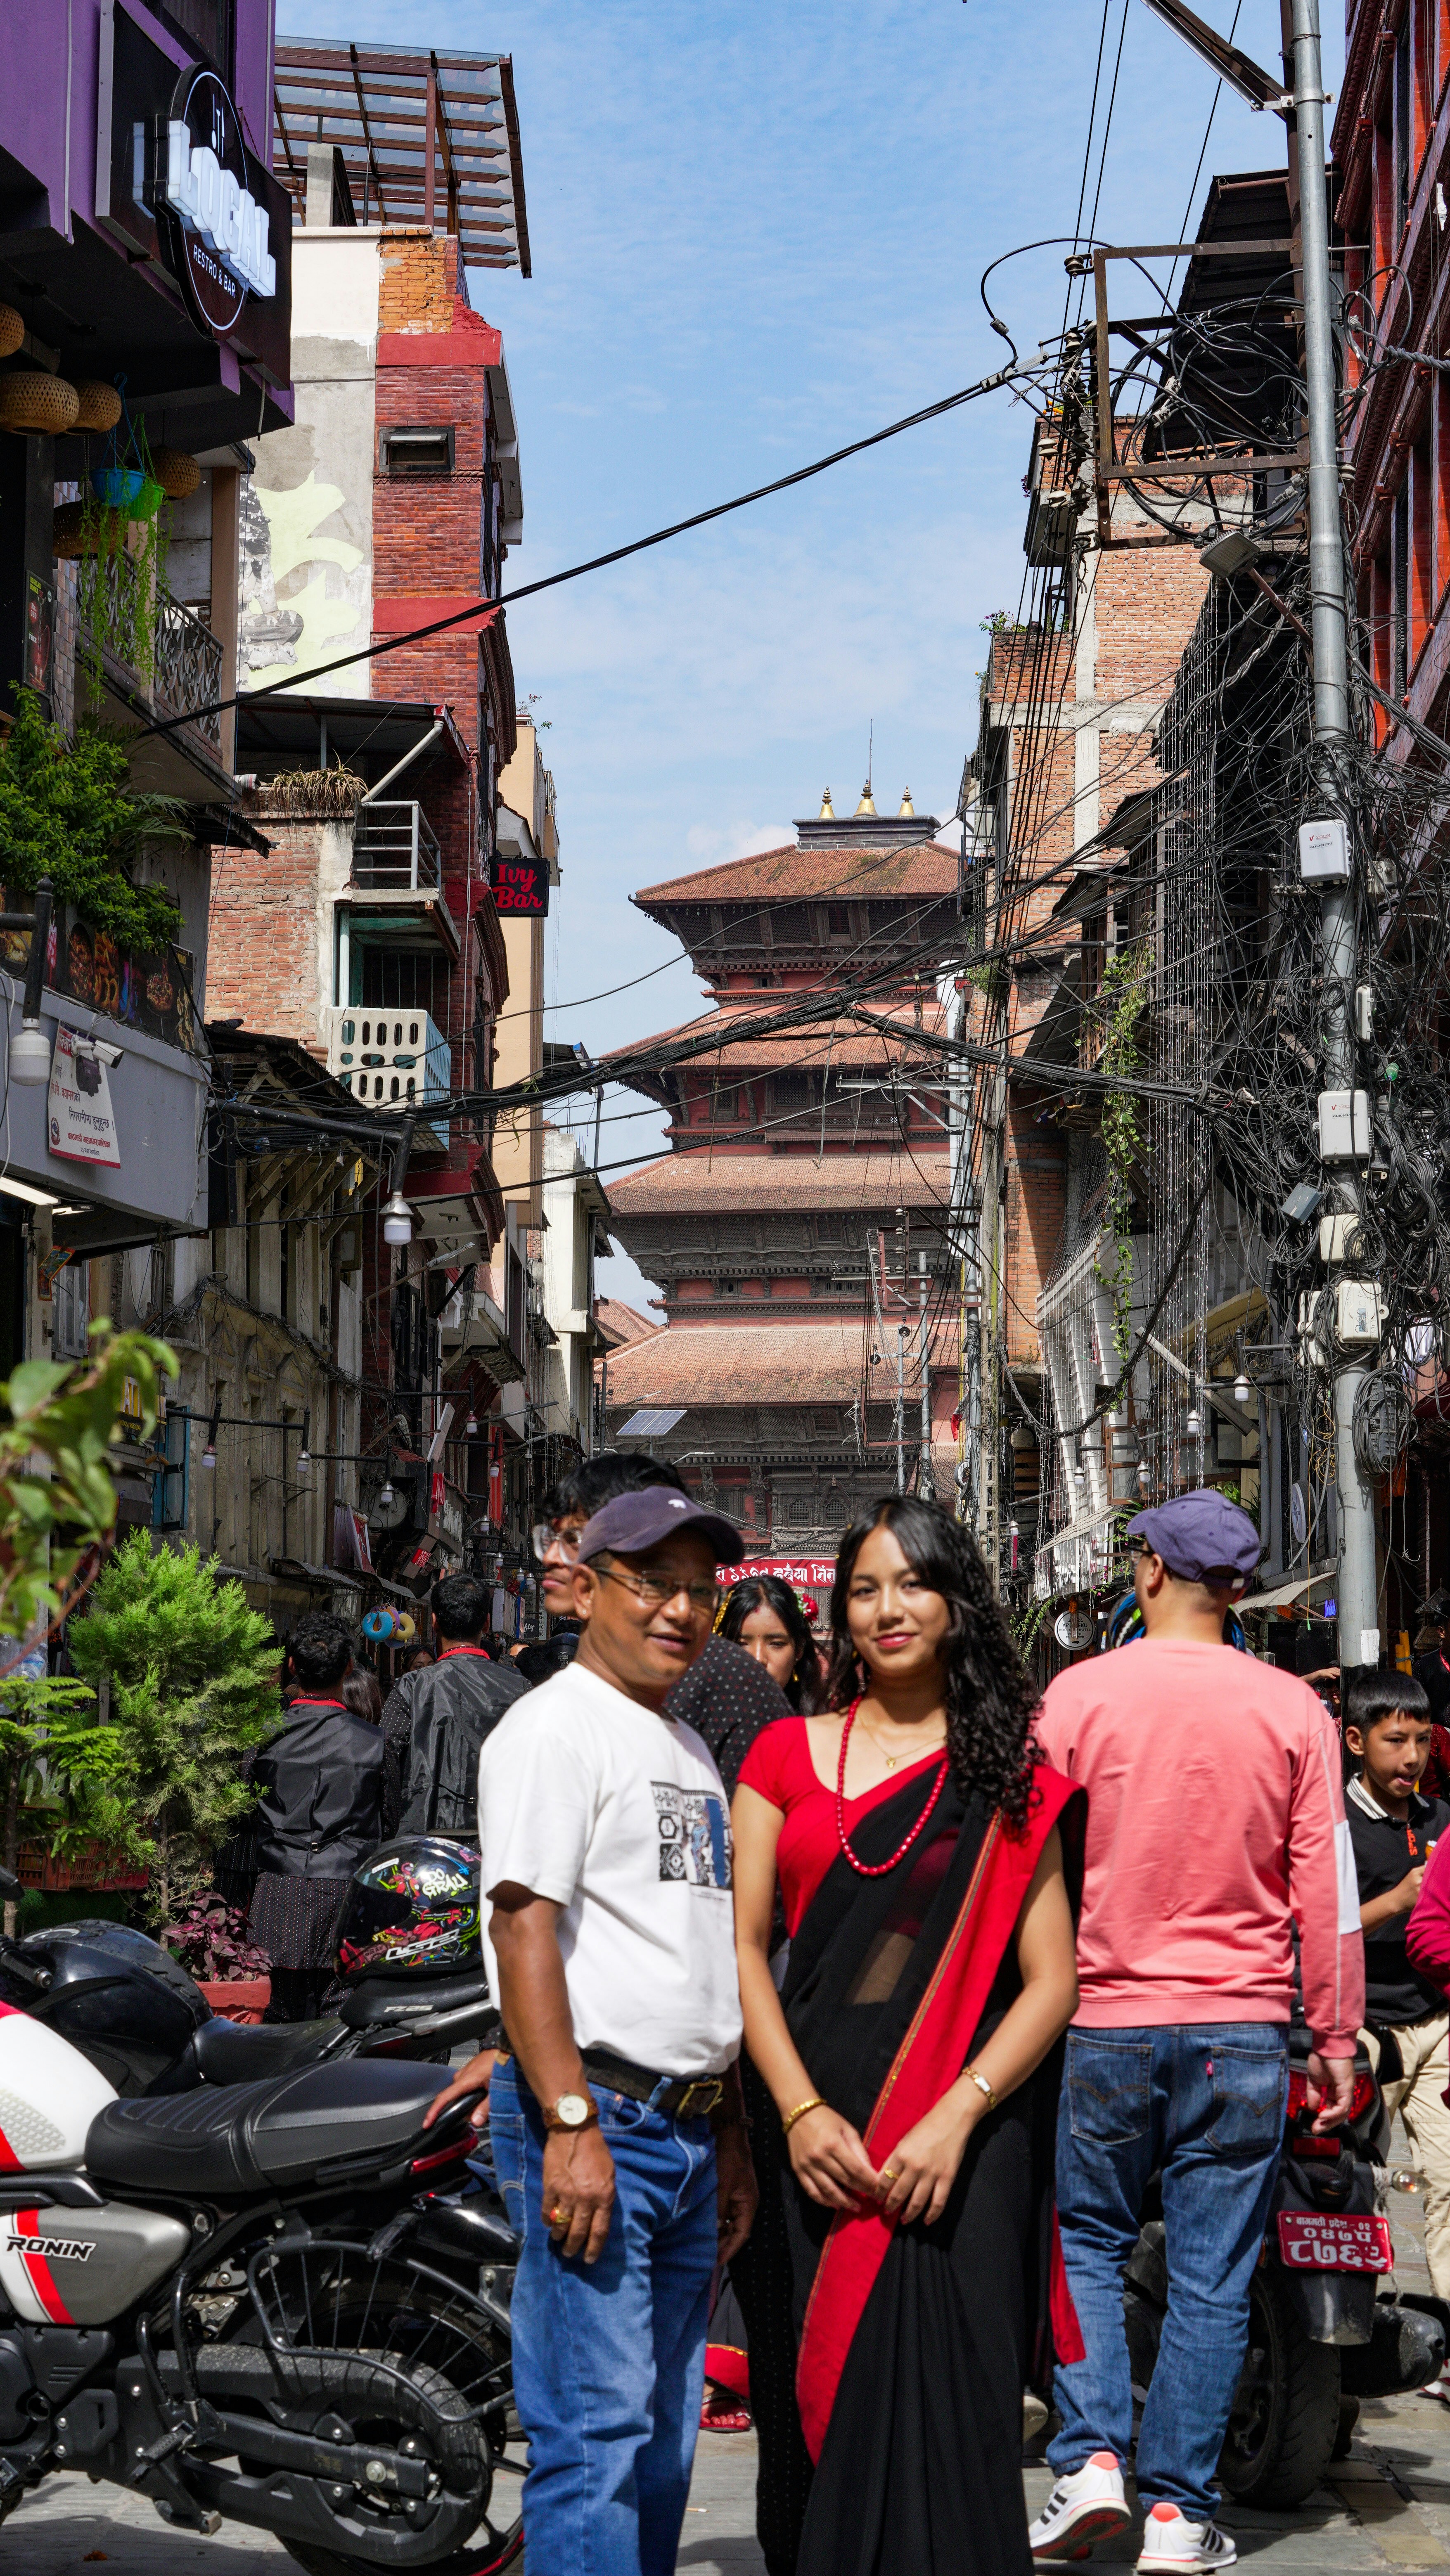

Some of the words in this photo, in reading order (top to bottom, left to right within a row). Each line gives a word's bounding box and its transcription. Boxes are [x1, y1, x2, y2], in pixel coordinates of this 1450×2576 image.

[168, 121, 275, 296] LOCAL
[193, 244, 217, 279] RESTRO
[218, 269, 223, 286] &
[224, 274, 236, 298] BAR
[496, 864, 537, 893] Ivy
[492, 886, 543, 909] Bar
[7, 2236, 92, 2259] RONIN
